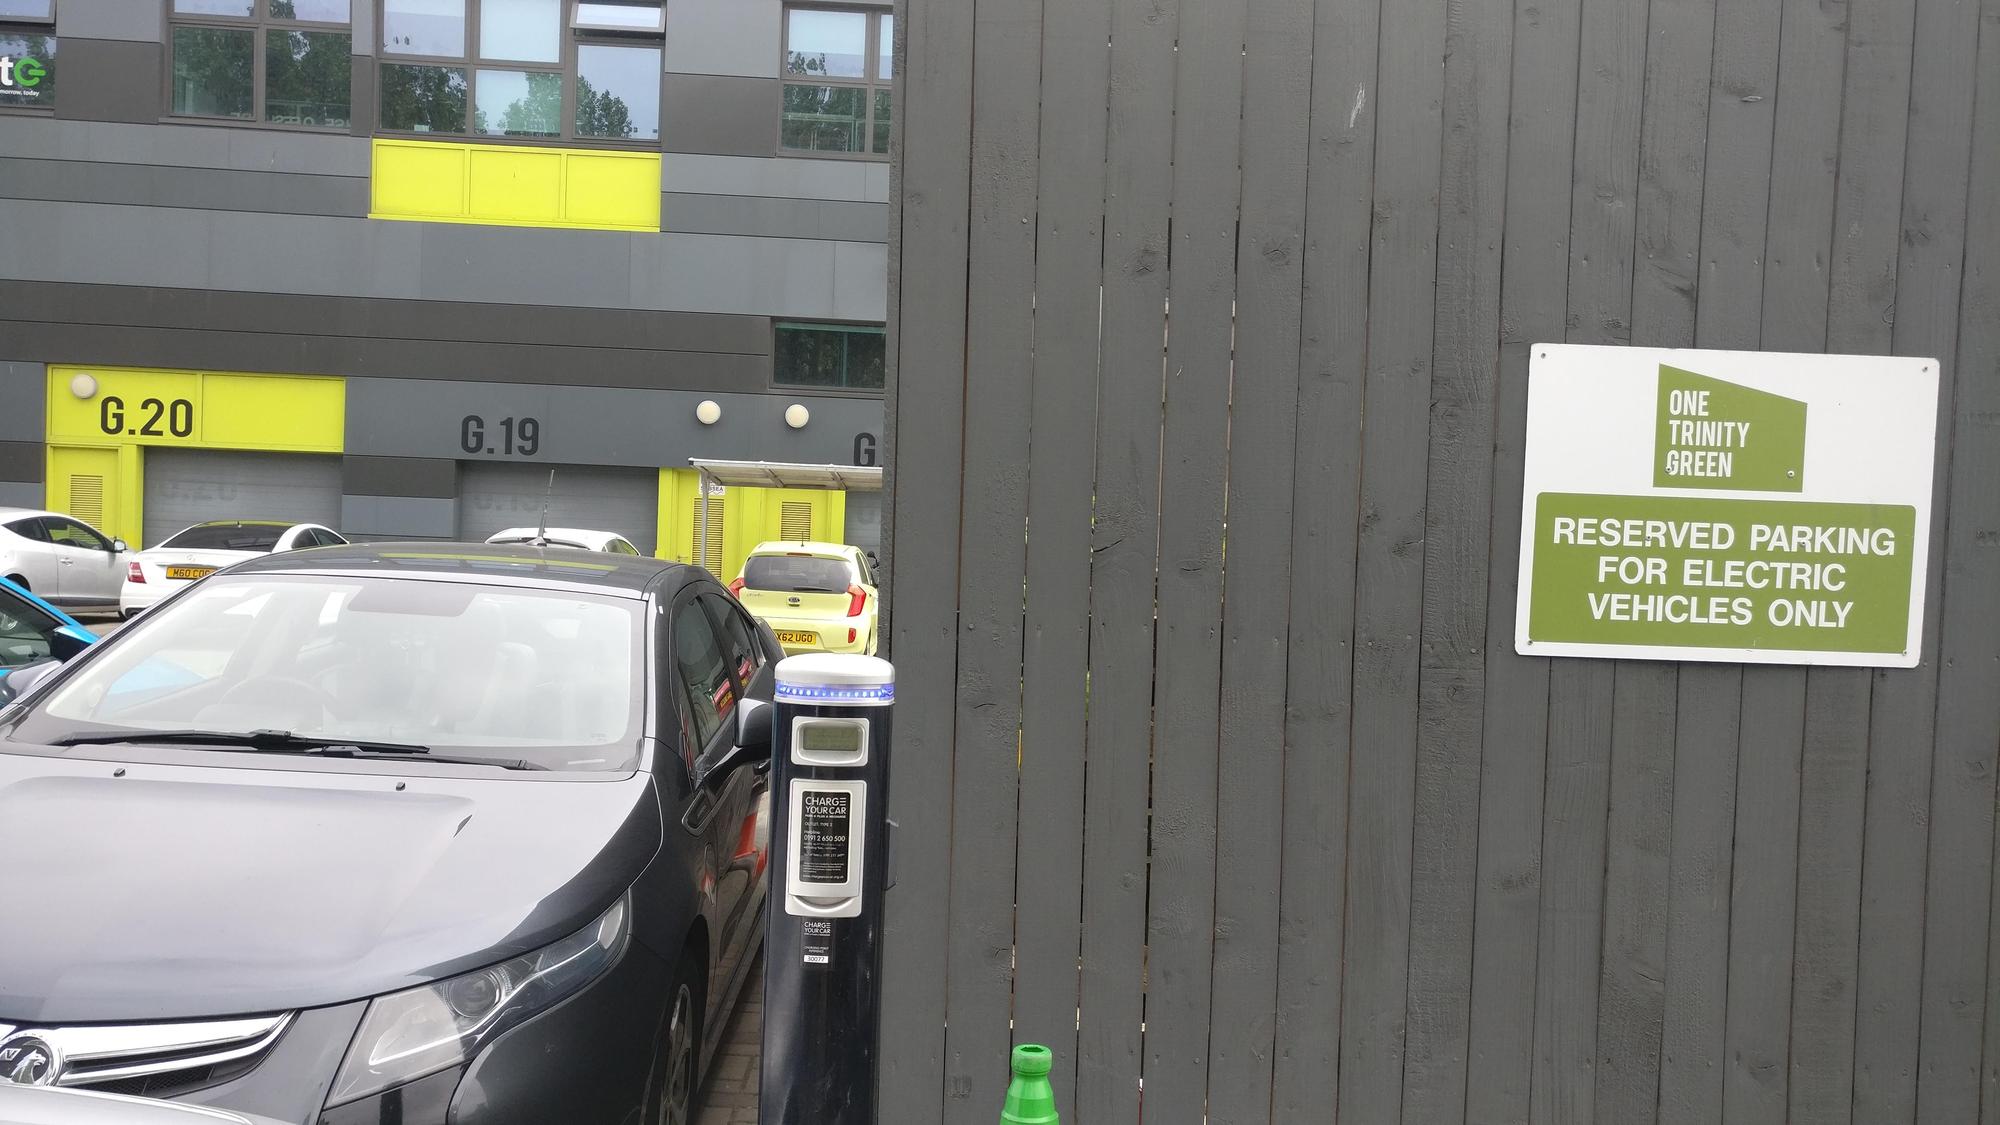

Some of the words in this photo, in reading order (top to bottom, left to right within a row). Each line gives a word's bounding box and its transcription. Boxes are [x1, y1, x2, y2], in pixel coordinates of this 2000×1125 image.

[100, 395, 193, 438] G.20
[1669, 389, 1710, 417] ONE
[461, 414, 540, 456] G.19
[1668, 420, 1750, 448] TRINITY
[1666, 449, 1732, 478] GREEN
[1552, 517, 1735, 551] RESERVED
[1749, 524, 1896, 557] PARKING
[1598, 556, 1668, 586] FOR
[1682, 559, 1847, 593] ELECTRIC
[1588, 593, 1753, 626] VEHICLES
[1768, 598, 1855, 629] ONLY
[805, 796, 847, 806] CHARGE
[805, 806, 828, 815] YOUR
[828, 806, 847, 815] CAR
[804, 921, 831, 929] CHARGE
